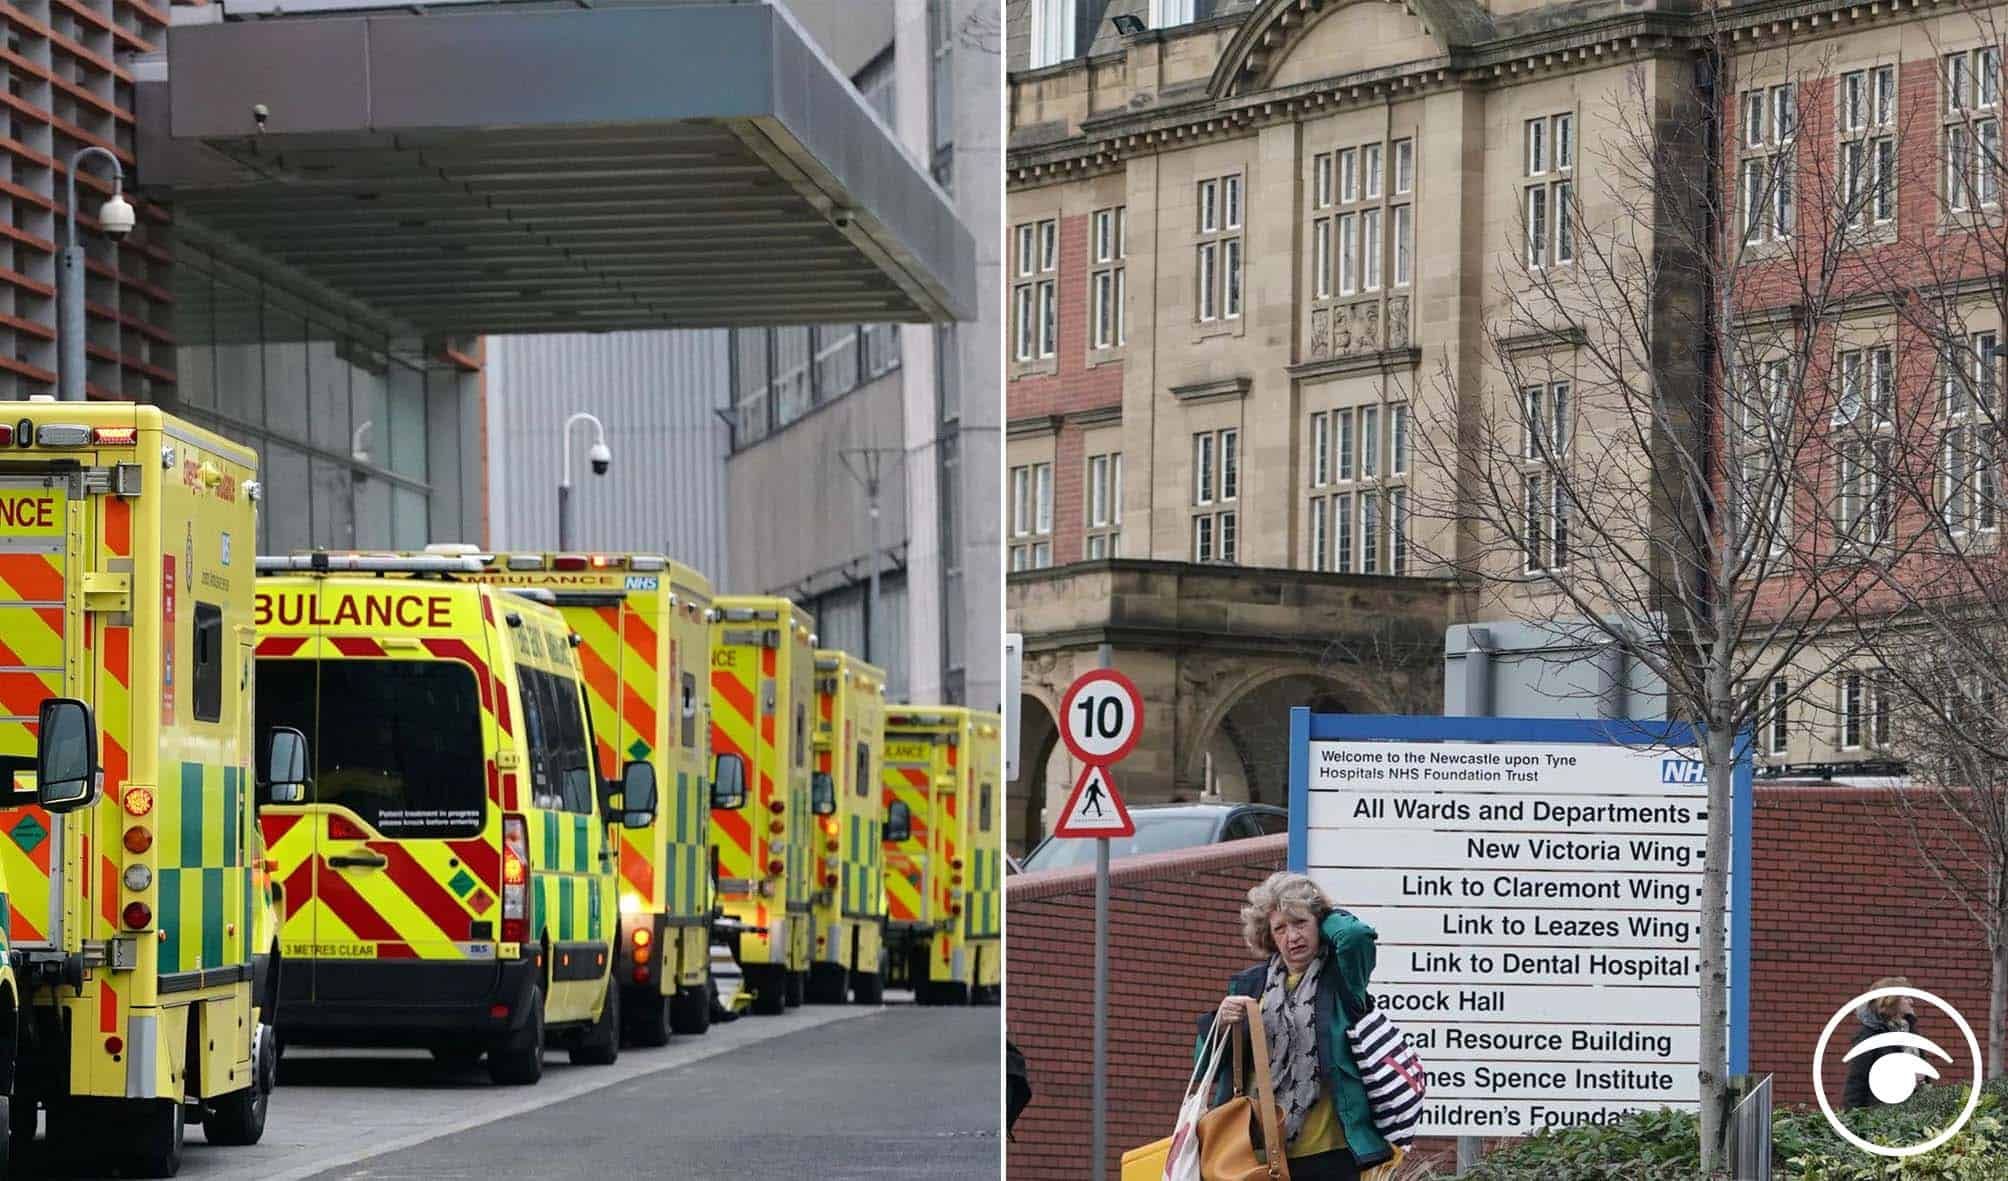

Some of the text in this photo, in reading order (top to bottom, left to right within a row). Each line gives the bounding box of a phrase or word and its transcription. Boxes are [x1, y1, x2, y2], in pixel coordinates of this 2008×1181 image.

[0, 497, 54, 527] NCE
[624, 576, 658, 590] NHS
[255, 593, 452, 627] BULANCE
[1077, 695, 1124, 739] 10
[1321, 749, 1578, 769] Welcome to the Newcastle upon Tyne
[1663, 760, 1708, 782] NH
[1319, 766, 1539, 783] Hospitals NHS Foundation Trust
[1352, 797, 1692, 827] All Wards and Departments
[1466, 837, 1691, 868] New Victoria Wing
[1401, 874, 1691, 906] Link to Claremont Wing
[1442, 913, 1690, 944] Link to Leazes Wing
[285, 943, 374, 956] 3 METRES CLEAR
[1410, 951, 1690, 982] Link to Dental Hospital
[1458, 990, 1506, 1013] Hall
[1444, 1028, 1564, 1052] Resource
[1571, 1029, 1673, 1058] Building
[1474, 1066, 1568, 1094] Spence
[1574, 1067, 1674, 1091] Institute
[1530, 1105, 1639, 1128] Founda
